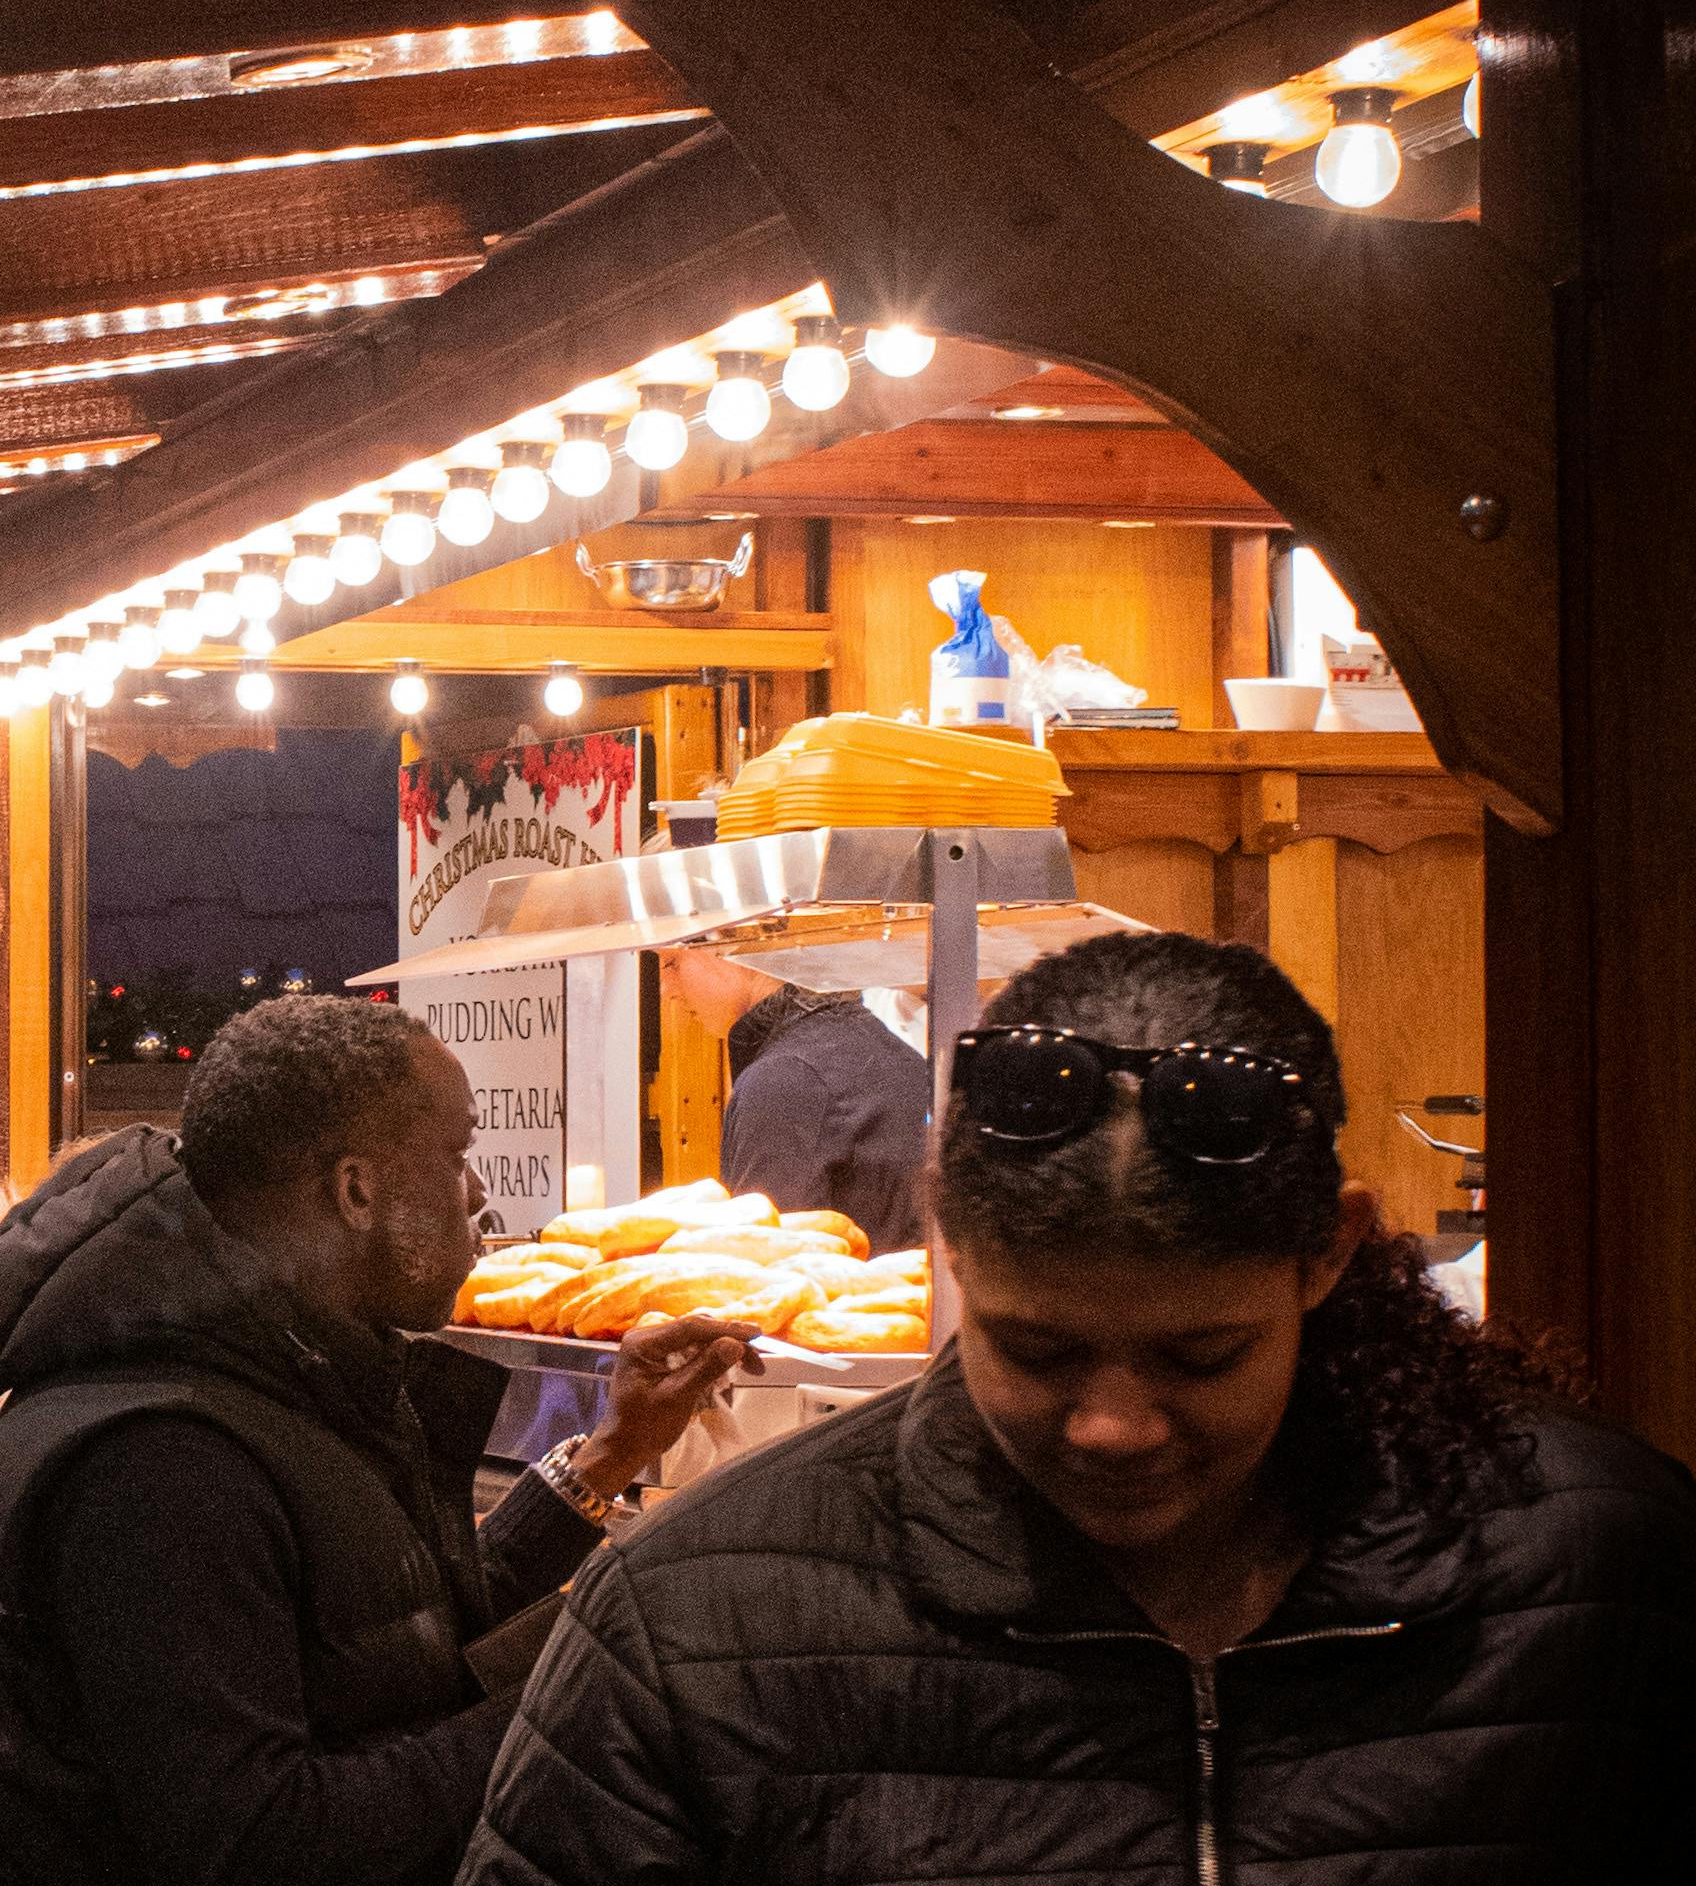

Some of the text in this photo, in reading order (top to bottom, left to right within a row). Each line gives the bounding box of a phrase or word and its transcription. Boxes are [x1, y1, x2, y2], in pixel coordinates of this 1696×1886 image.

[408, 817, 576, 936] CHRISTMAS ROAST
[427, 997, 533, 1044] PUDDING
[474, 1087, 565, 1130] GETARIA
[478, 1155, 551, 1198] WRAPS
